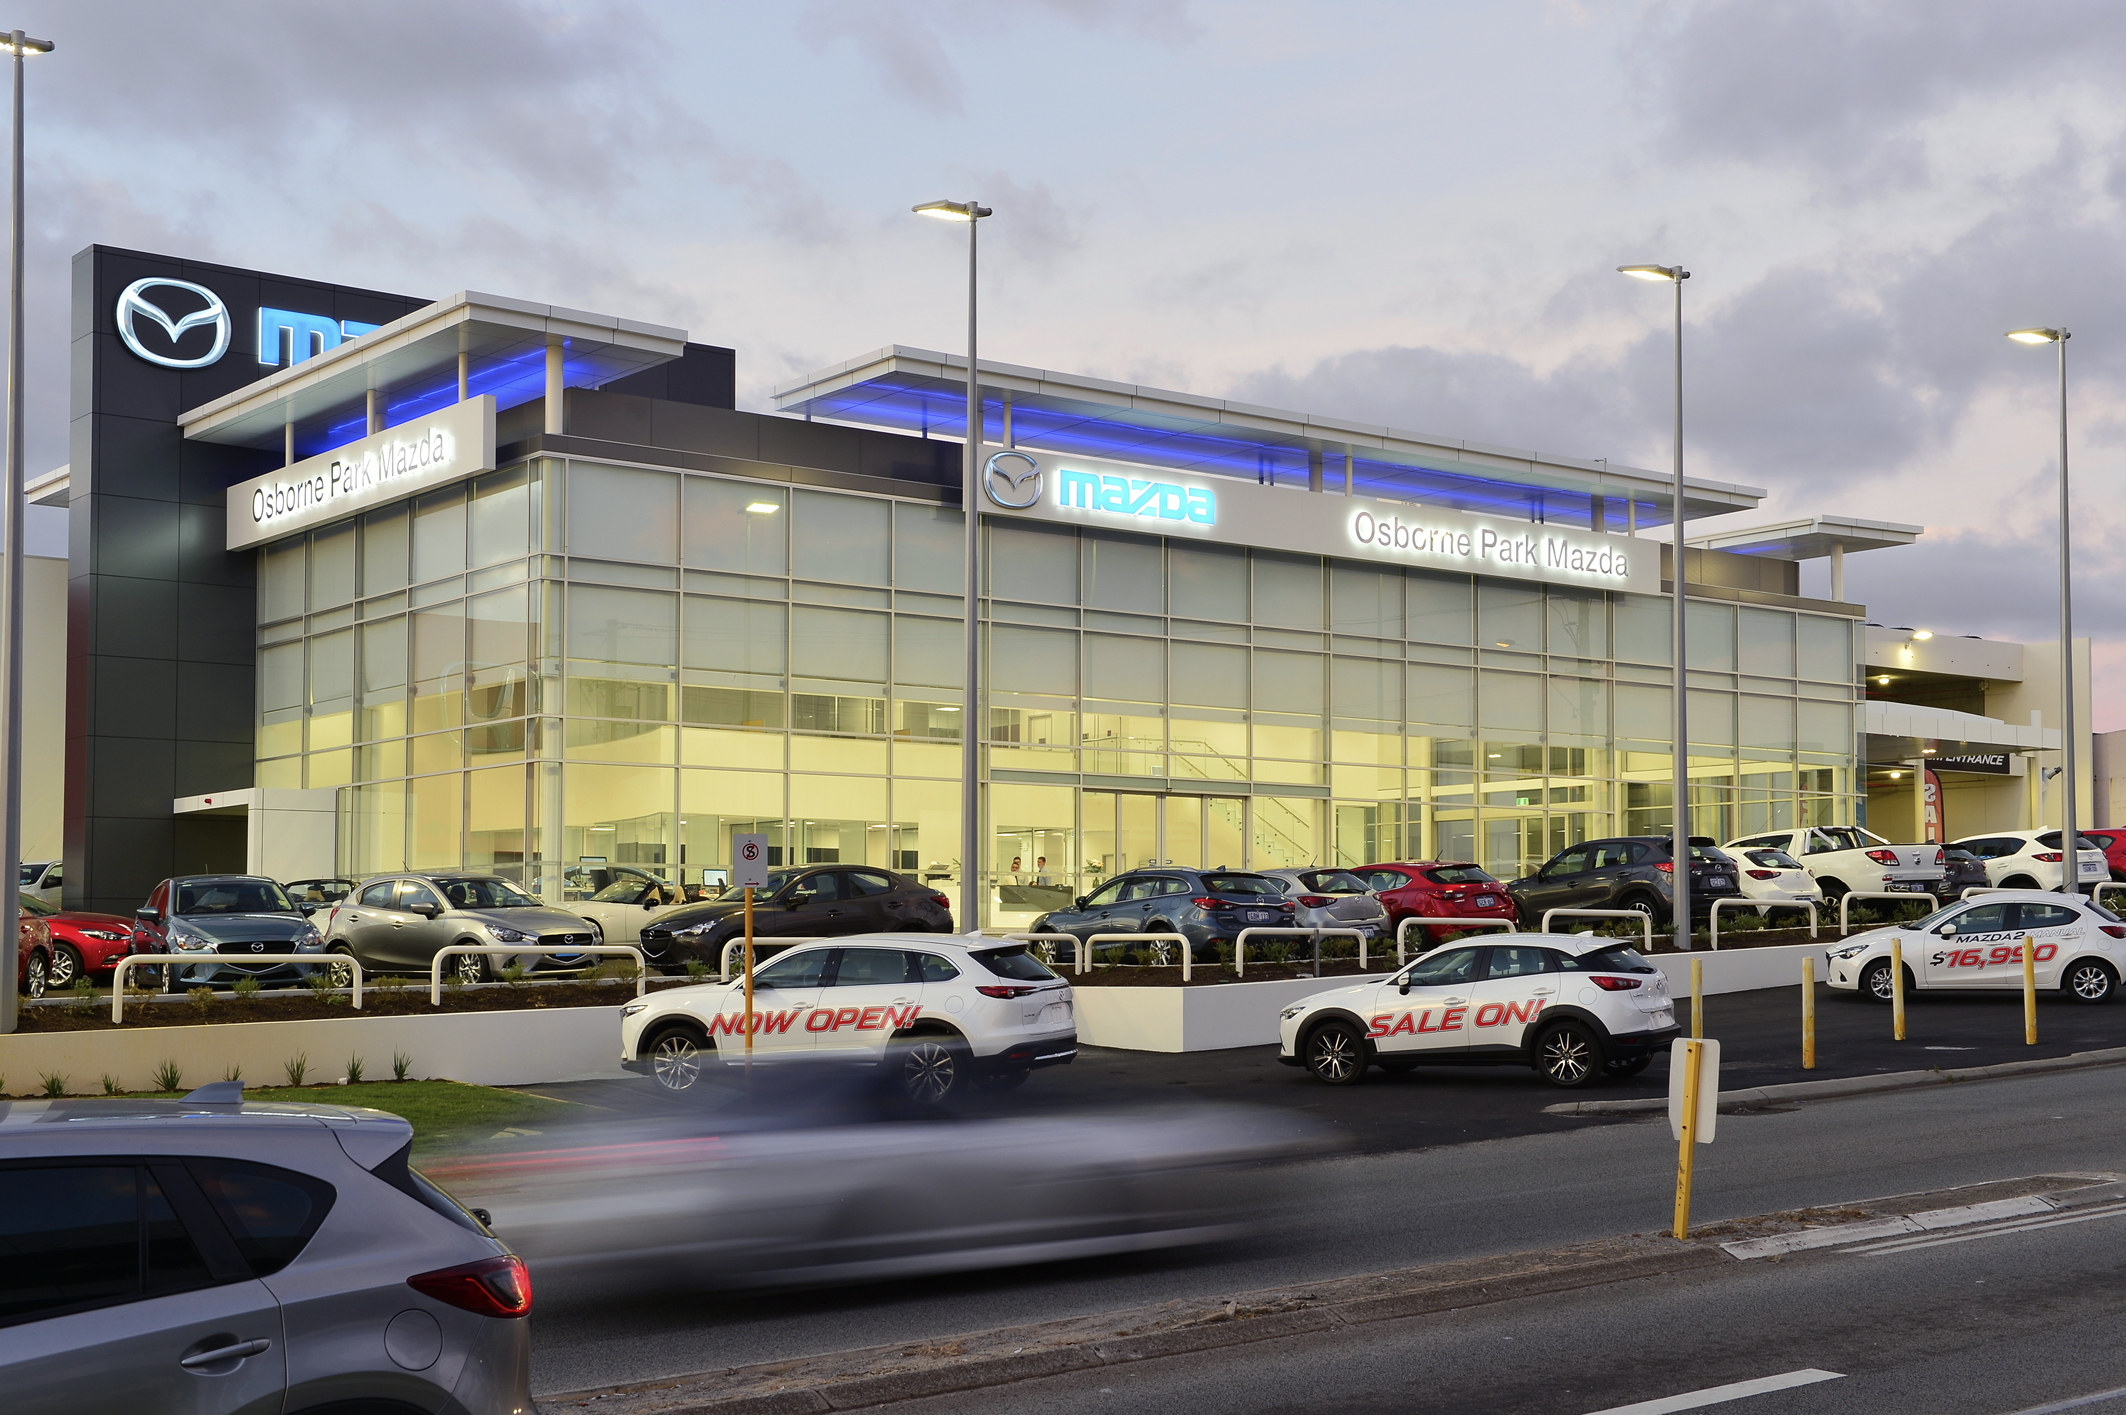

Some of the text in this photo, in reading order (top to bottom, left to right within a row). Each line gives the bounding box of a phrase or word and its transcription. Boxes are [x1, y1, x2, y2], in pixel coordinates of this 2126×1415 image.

[252, 427, 445, 523] Osborne Park Mazda
[1355, 511, 1629, 578] Osborne Park Mazda
[1955, 926, 2086, 944] MAZDA2 MANUAL
[707, 1004, 924, 1037] NOW OPEN!
[1364, 997, 1548, 1040] SALE ON!
